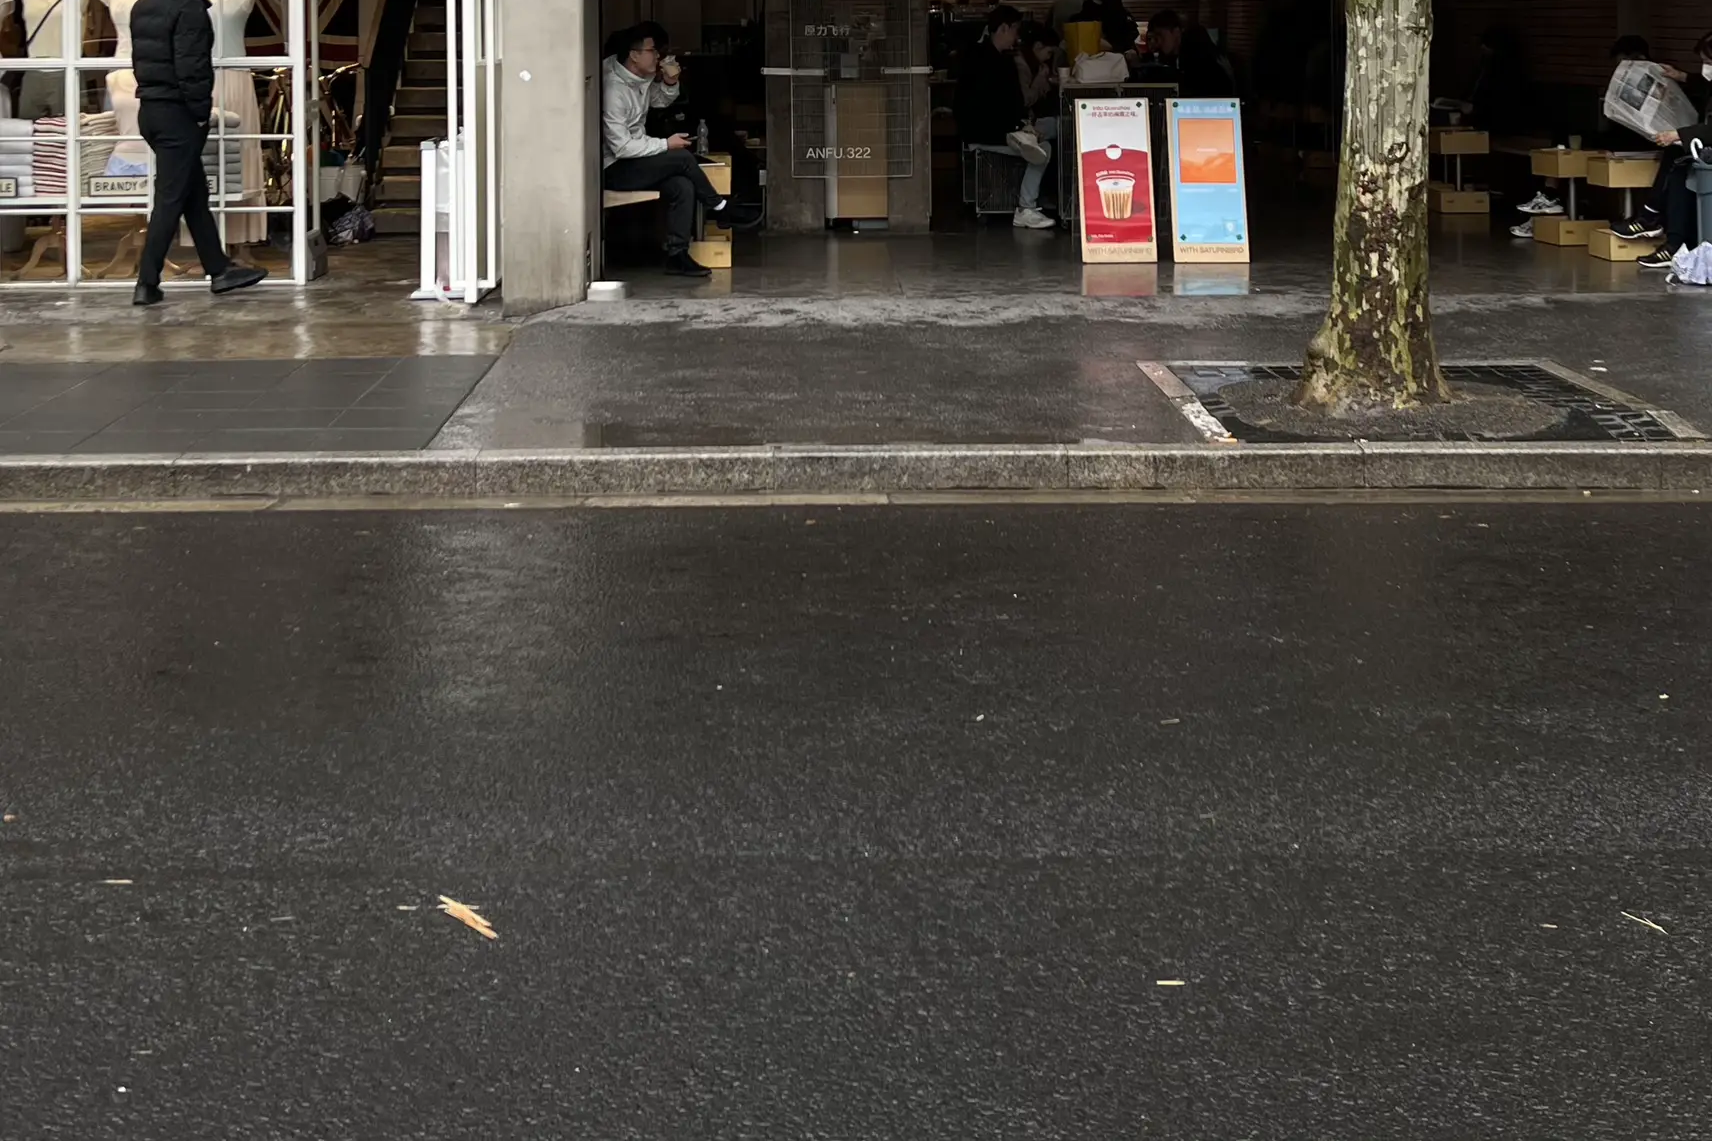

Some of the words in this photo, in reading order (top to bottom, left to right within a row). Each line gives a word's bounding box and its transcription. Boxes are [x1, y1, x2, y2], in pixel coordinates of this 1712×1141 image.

[804, 24, 852, 37] 原力飞行
[94, 181, 138, 192] BRANDY
[1180, 246, 1198, 254] WITH
